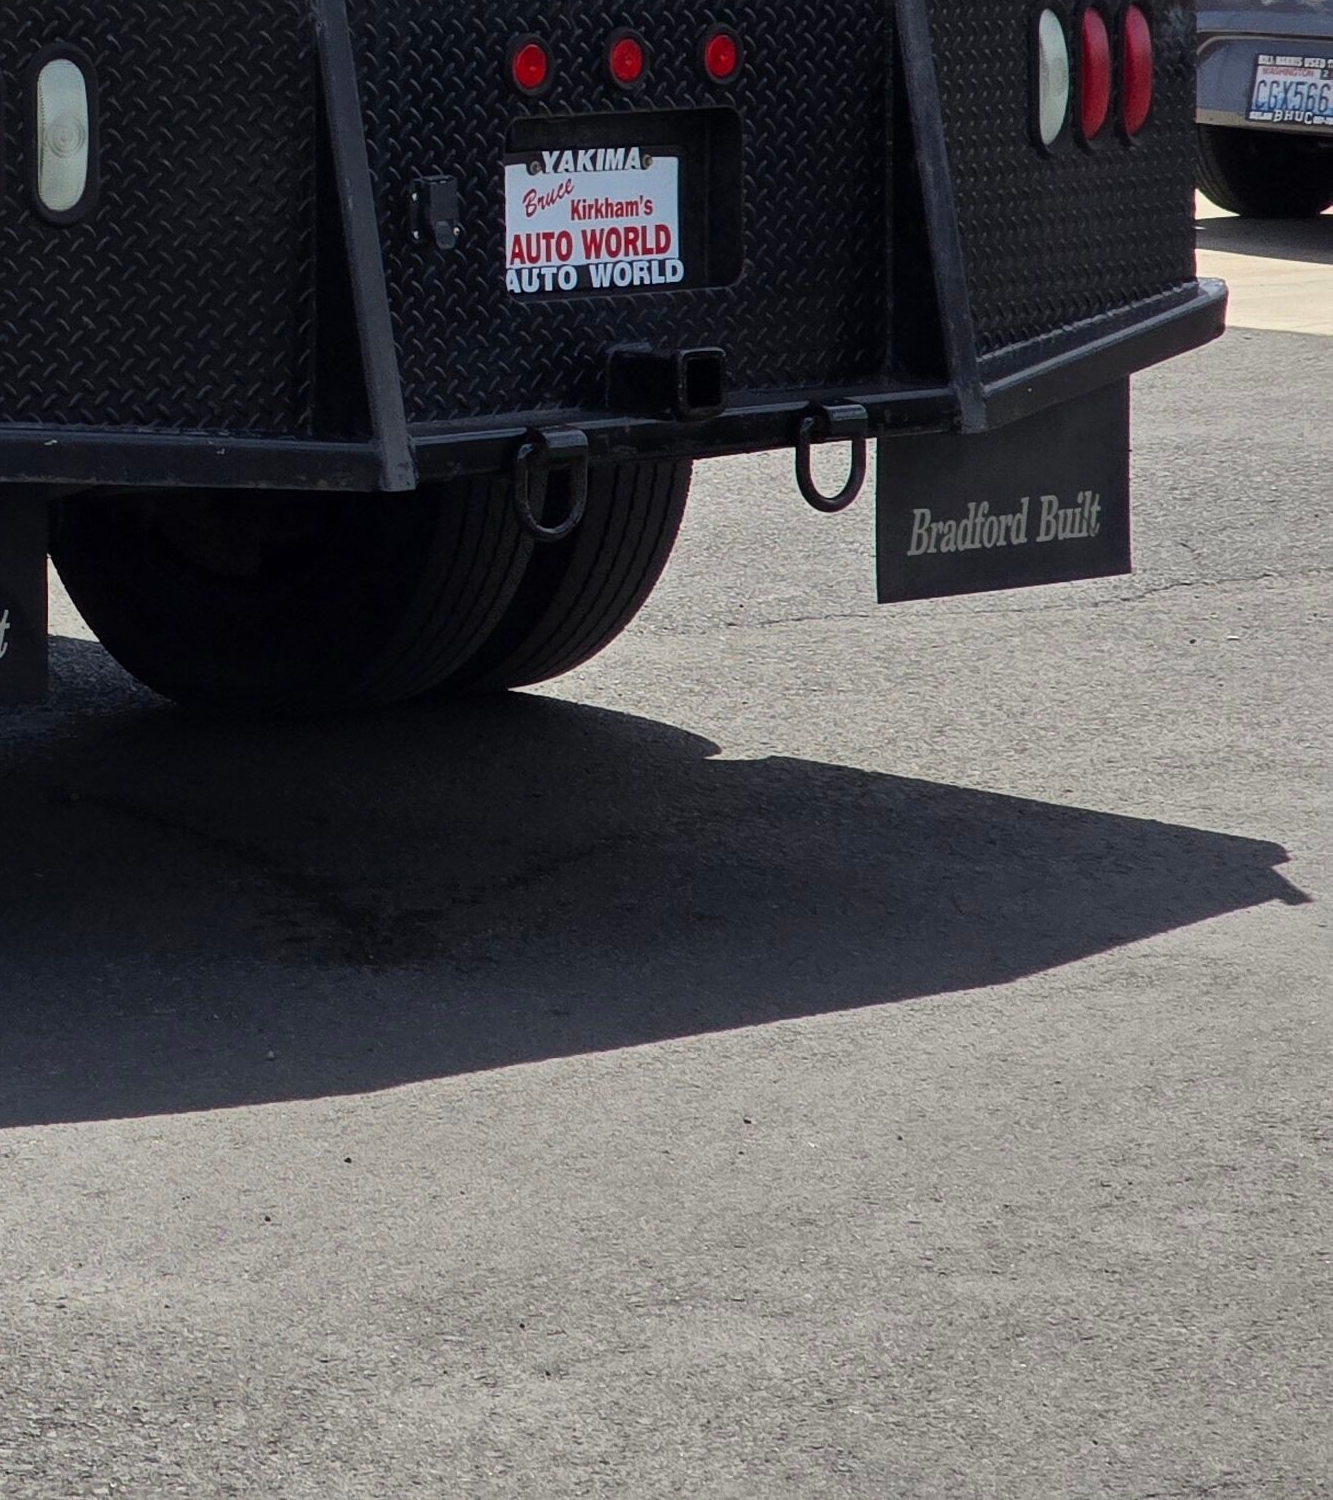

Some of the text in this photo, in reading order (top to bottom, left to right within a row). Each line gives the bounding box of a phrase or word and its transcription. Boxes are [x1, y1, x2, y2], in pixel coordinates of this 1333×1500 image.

[1273, 109, 1313, 125] BHUC
[542, 147, 642, 175] YAKIMA
[522, 178, 575, 218] Bruce
[571, 195, 653, 221] Kirkham's
[510, 224, 671, 265] AUTO WORLD
[506, 259, 684, 294] AUTO WORLD
[907, 490, 1101, 556] Bradford Built
